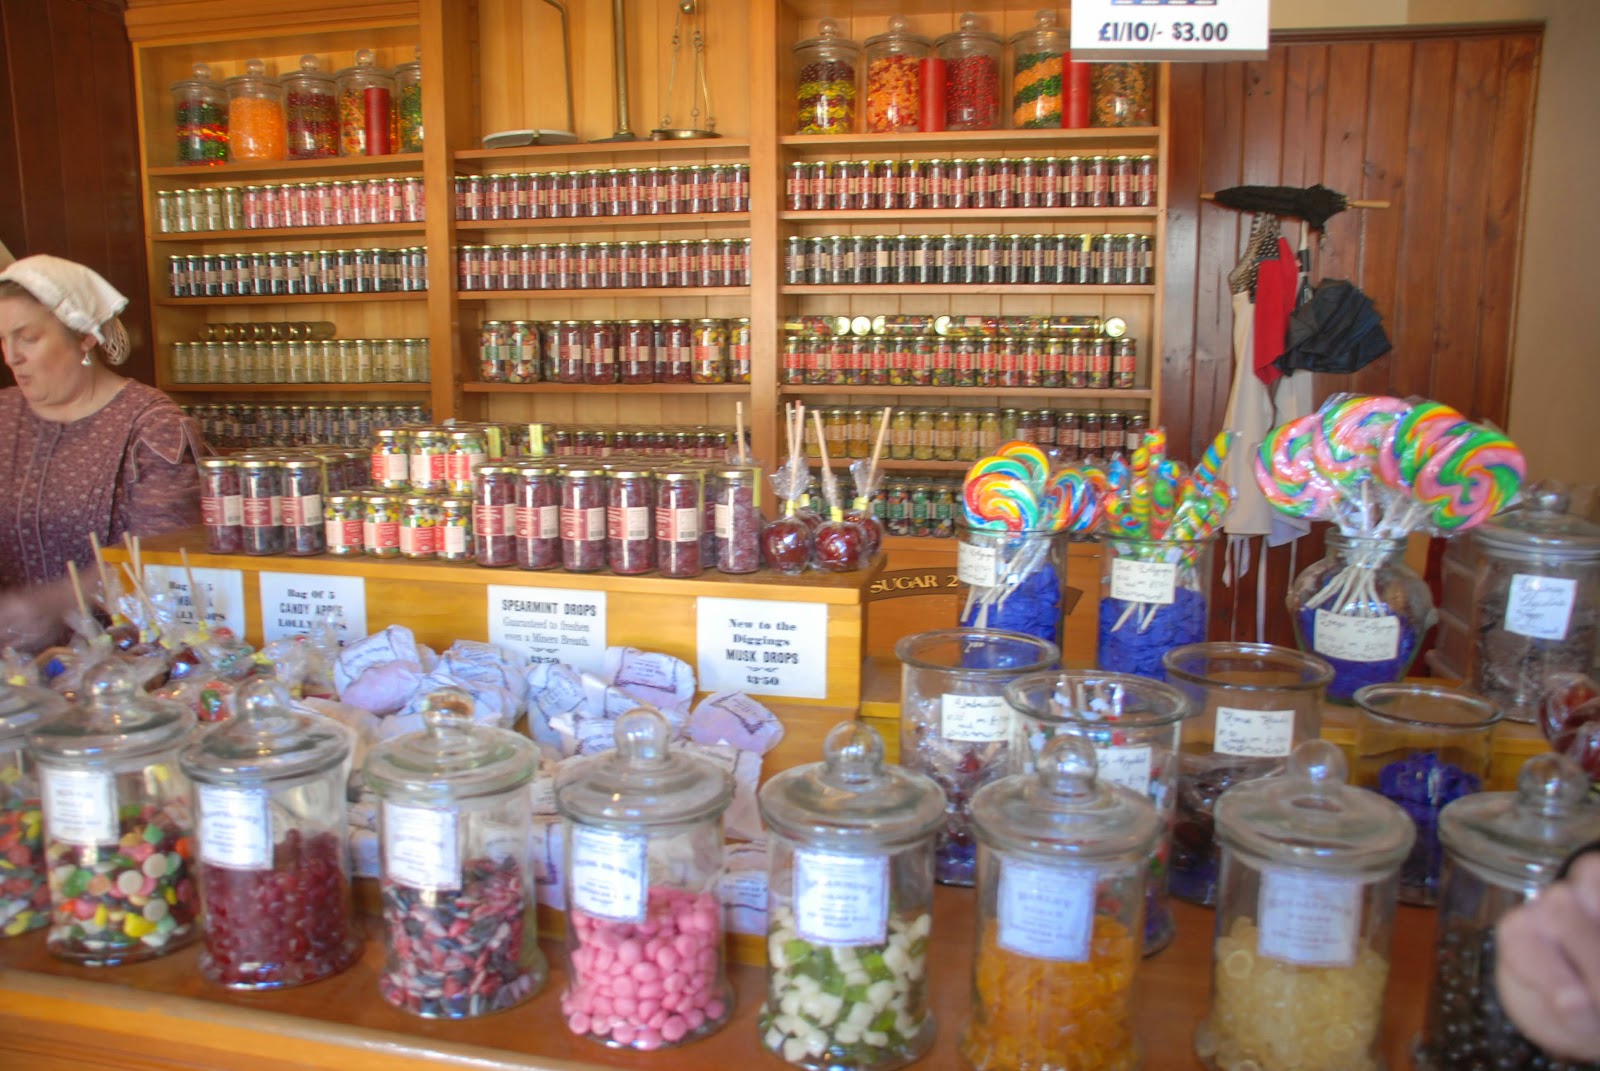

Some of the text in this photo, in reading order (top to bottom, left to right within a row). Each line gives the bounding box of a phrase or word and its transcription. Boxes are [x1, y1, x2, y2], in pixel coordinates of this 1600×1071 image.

[1172, 22, 1228, 42] $3.00
[870, 575, 938, 594] SUGAR
[287, 588, 308, 599] Bag
[280, 602, 310, 615] CANDY
[502, 599, 597, 616] SPEARMINT DROPS
[503, 617, 590, 632] Guaranteed to freshen
[728, 618, 798, 632] New to the
[733, 634, 791, 647] Diggings
[726, 649, 799, 665] MUSK DROPS
